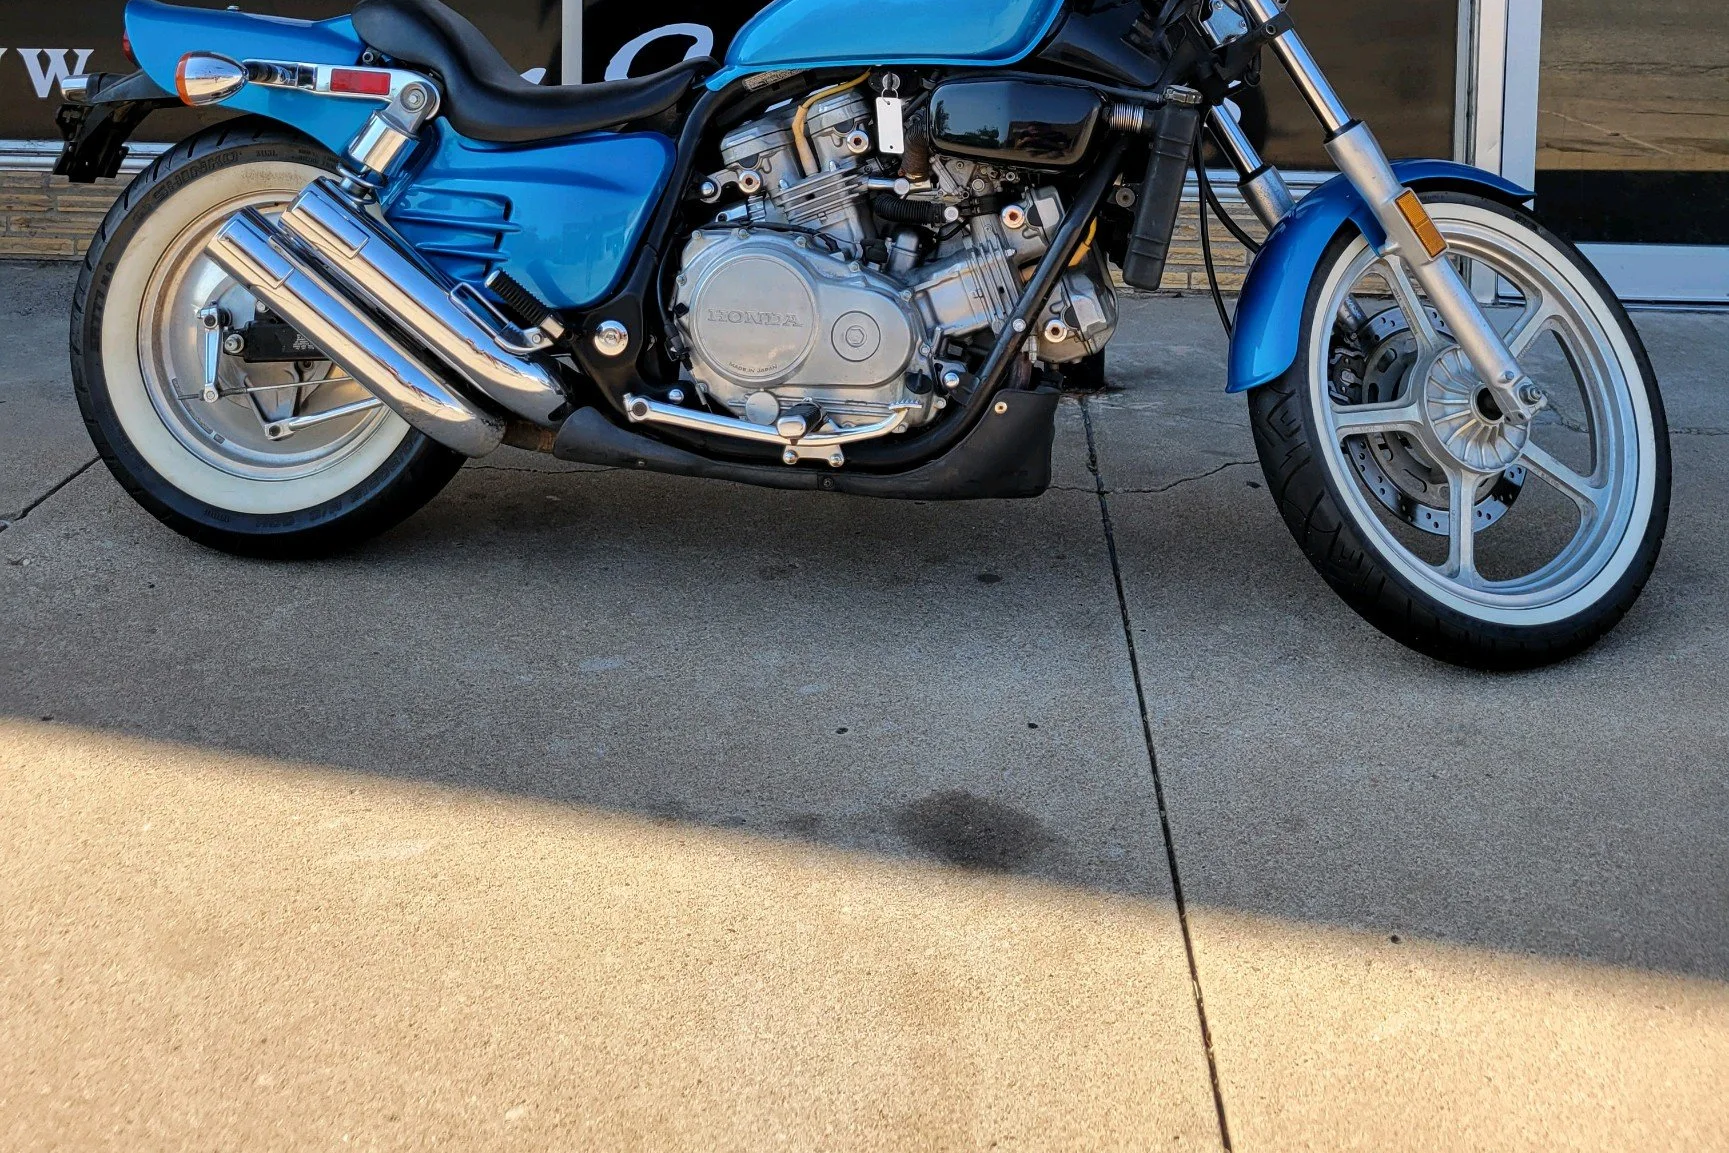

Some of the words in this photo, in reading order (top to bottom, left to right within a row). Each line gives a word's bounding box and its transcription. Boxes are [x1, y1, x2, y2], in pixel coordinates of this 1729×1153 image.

[707, 309, 804, 328] HONDA
[729, 361, 747, 372] MADE
[757, 364, 778, 373] JAPAN
